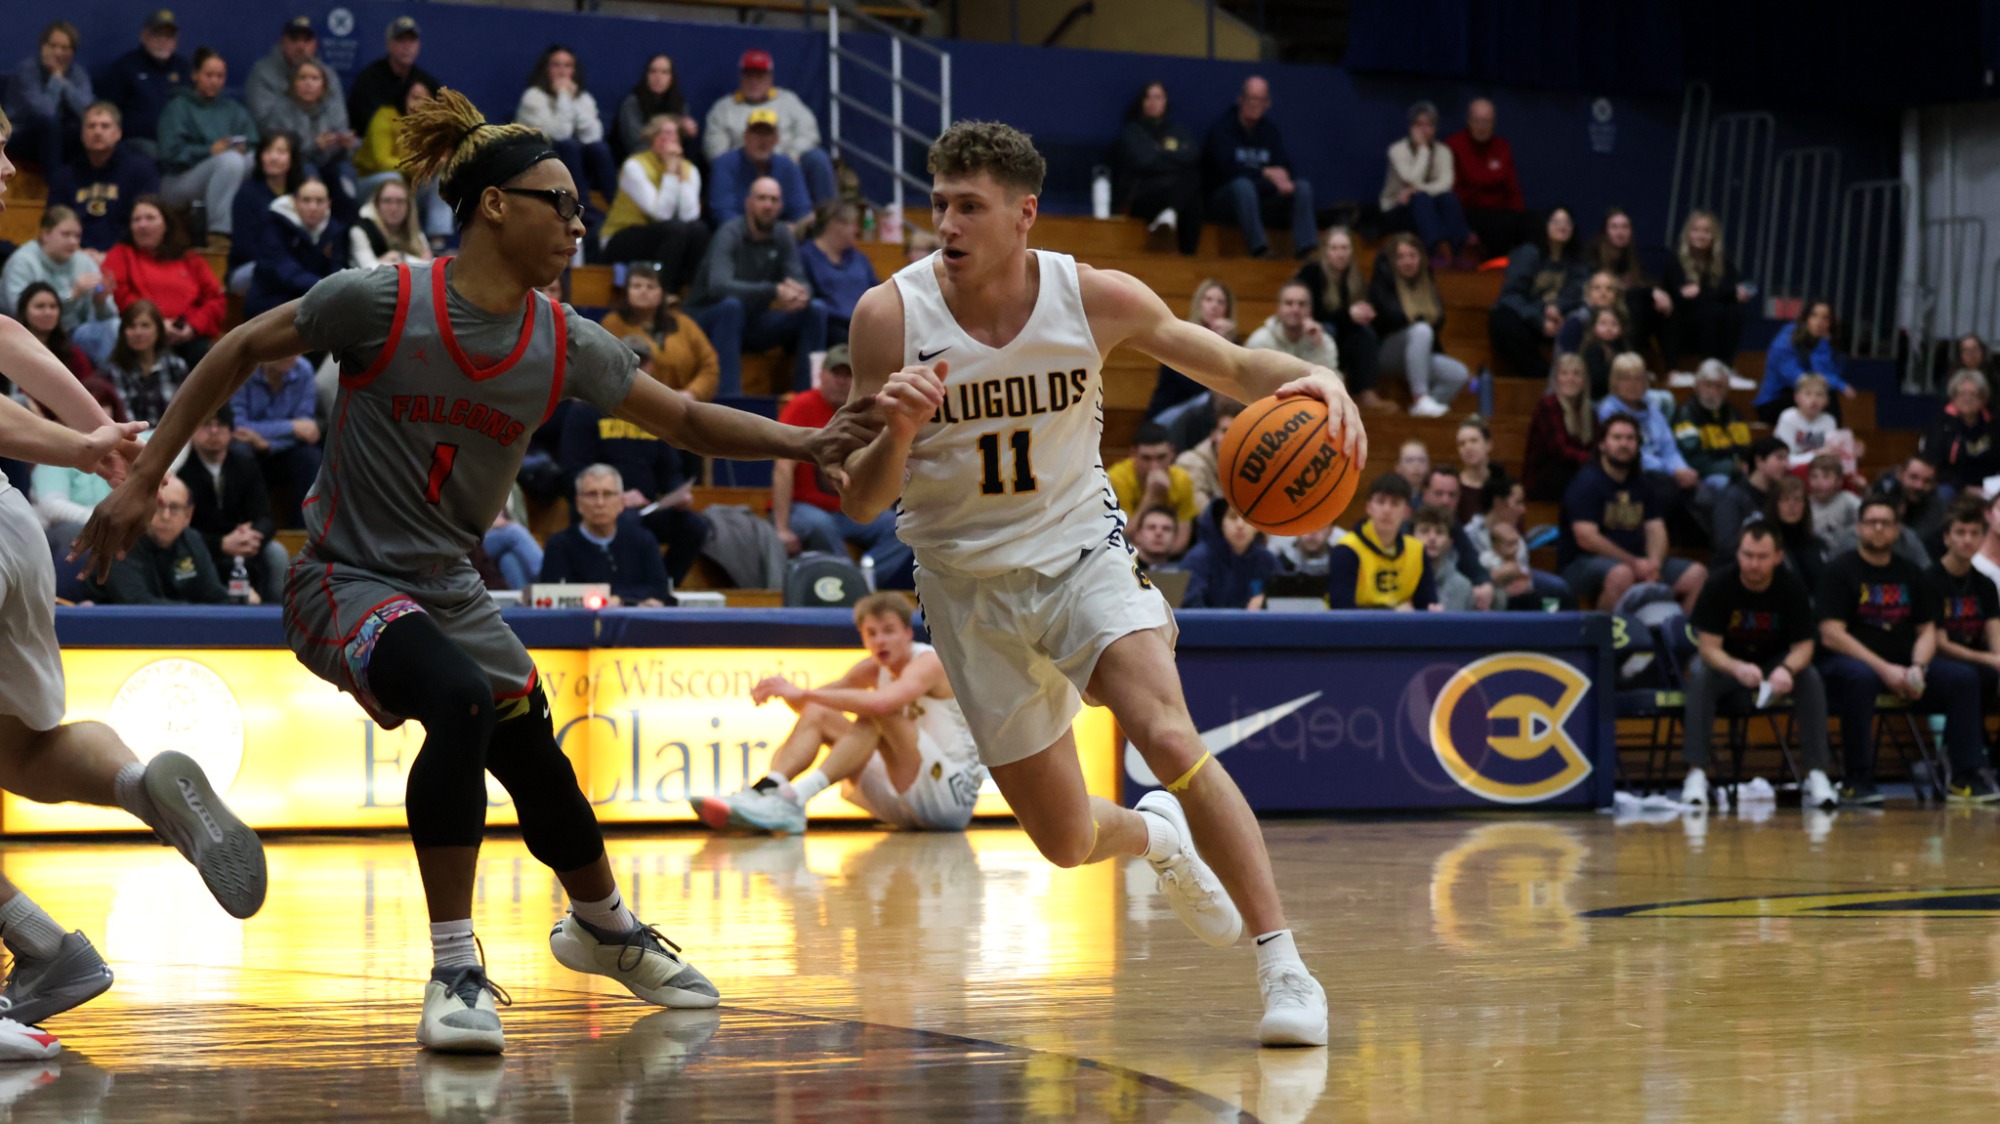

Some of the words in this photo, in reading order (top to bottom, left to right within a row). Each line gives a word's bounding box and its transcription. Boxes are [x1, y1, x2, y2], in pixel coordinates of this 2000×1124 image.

[392, 395, 525, 447] FALCONS
[930, 369, 1087, 424] LUGOLDS
[424, 442, 459, 505] 1
[976, 428, 1038, 496] 11
[1239, 410, 1314, 484] Wilson
[1284, 443, 1337, 504] NCAA
[575, 663, 606, 706] of
[614, 659, 811, 699] Wisconn
[555, 709, 768, 806] Clair
